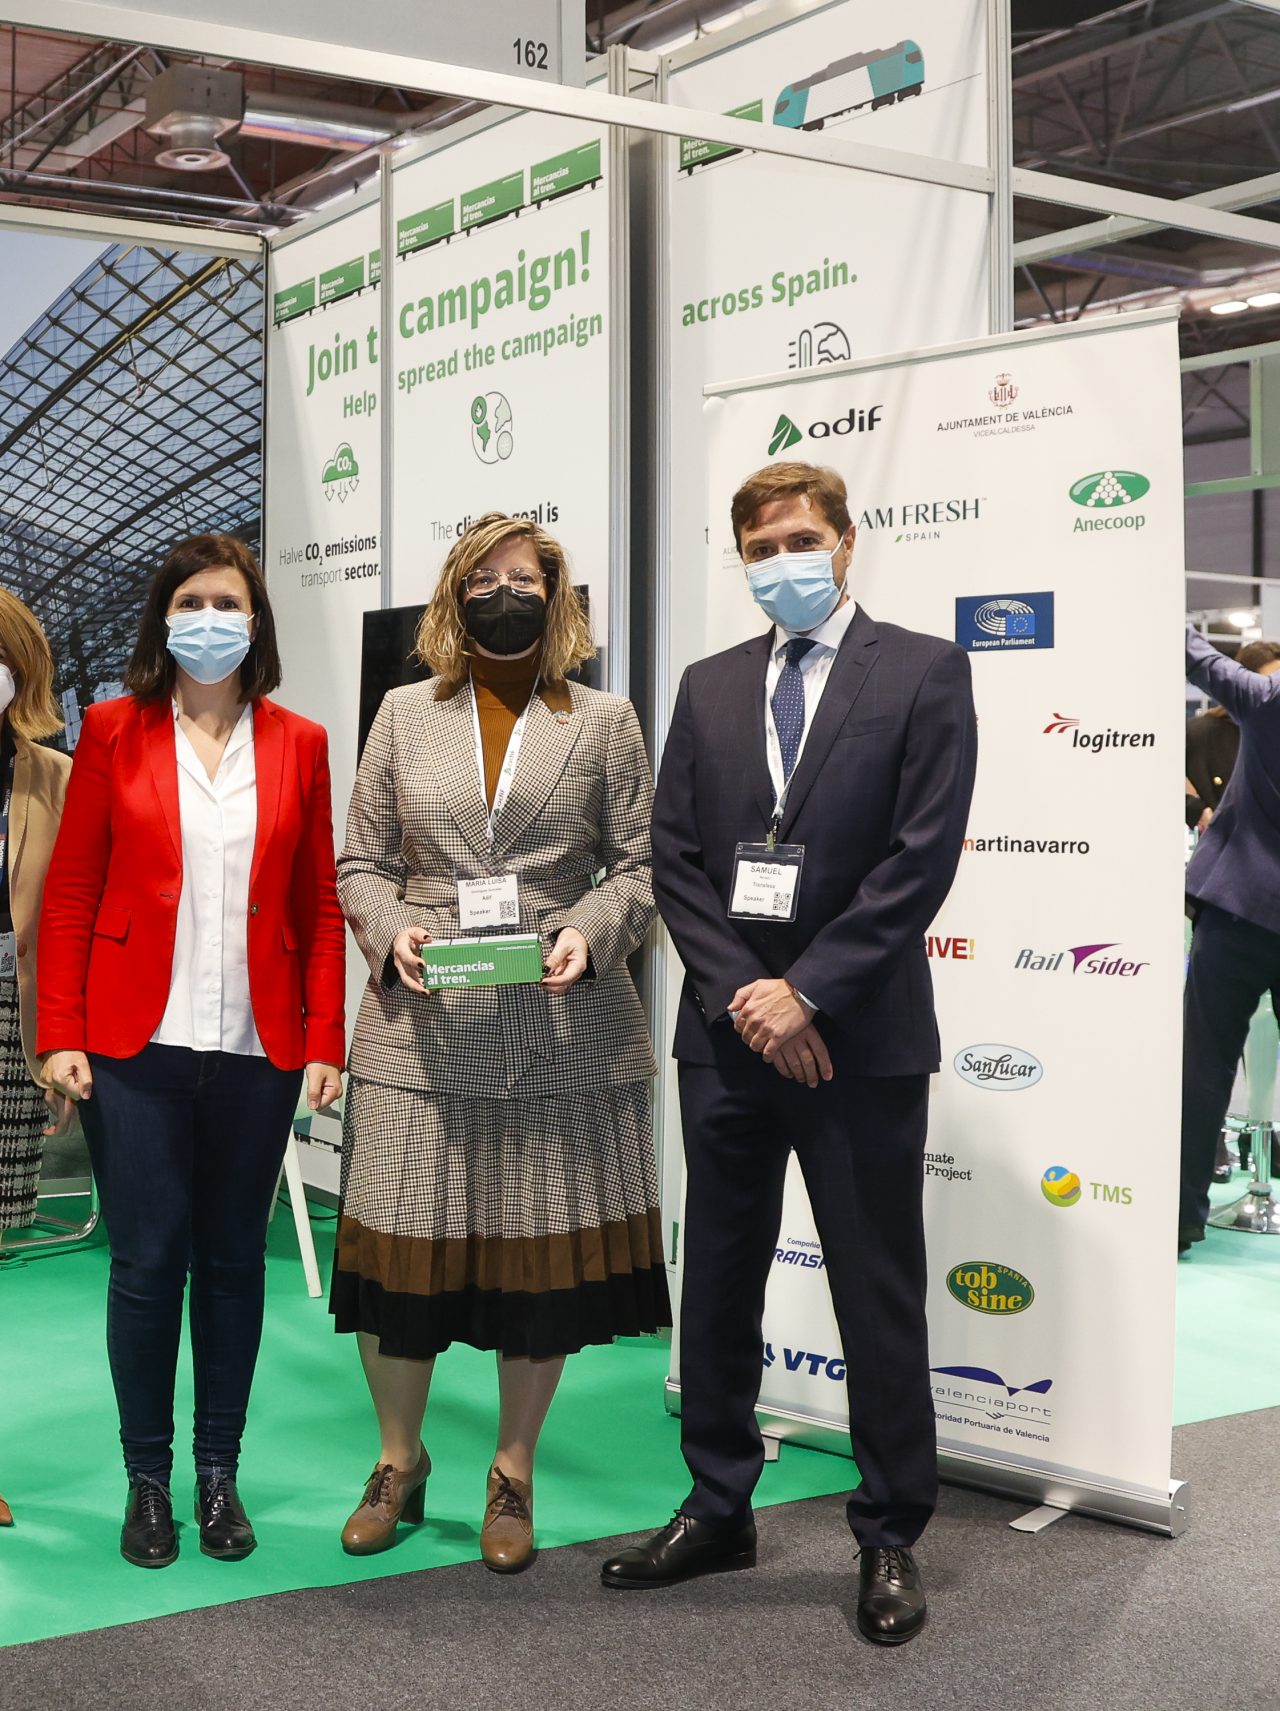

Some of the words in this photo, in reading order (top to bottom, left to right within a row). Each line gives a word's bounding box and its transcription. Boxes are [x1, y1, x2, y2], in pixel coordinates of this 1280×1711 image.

[513, 37, 548, 70] 162
[399, 229, 590, 339] campaign!
[682, 285, 763, 326] across
[771, 257, 858, 307] Spain.
[307, 332, 358, 396] Join
[398, 349, 458, 394] spread
[465, 338, 495, 371] the
[502, 313, 603, 361] campaign
[343, 390, 377, 419] Help
[808, 404, 884, 440] adif
[937, 414, 1002, 432] AJUNTAMENT
[1005, 412, 1019, 423] DE
[431, 521, 453, 541] The
[547, 501, 558, 523] is
[858, 507, 893, 530] AM
[902, 498, 979, 526] FRESH
[1072, 512, 1146, 533] Anecoop
[905, 531, 940, 541] SPAIN
[280, 547, 303, 565] Halve
[325, 534, 376, 557] emissions
[301, 568, 342, 588] transport
[344, 562, 381, 580] sector.
[972, 639, 1000, 648] European
[1001, 637, 1035, 646] Parliament
[1072, 729, 1155, 753] logitren
[488, 877, 507, 885] LUISA
[751, 865, 782, 875] SAMUEL
[744, 894, 765, 902] Speaker
[426, 960, 495, 975] Mercancías
[427, 975, 438, 986] al
[440, 975, 470, 985] tren.
[962, 1053, 1037, 1081] SanLucar
[925, 1163, 972, 1181] Project
[1089, 1181, 1132, 1205] TMS
[955, 1266, 997, 1289] tob
[967, 1287, 1023, 1310] sine
[783, 1348, 847, 1380] VTG
[964, 1418, 1001, 1432] Portuaria
[1003, 1426, 1013, 1434] de
[1016, 1428, 1050, 1443] Valencia
